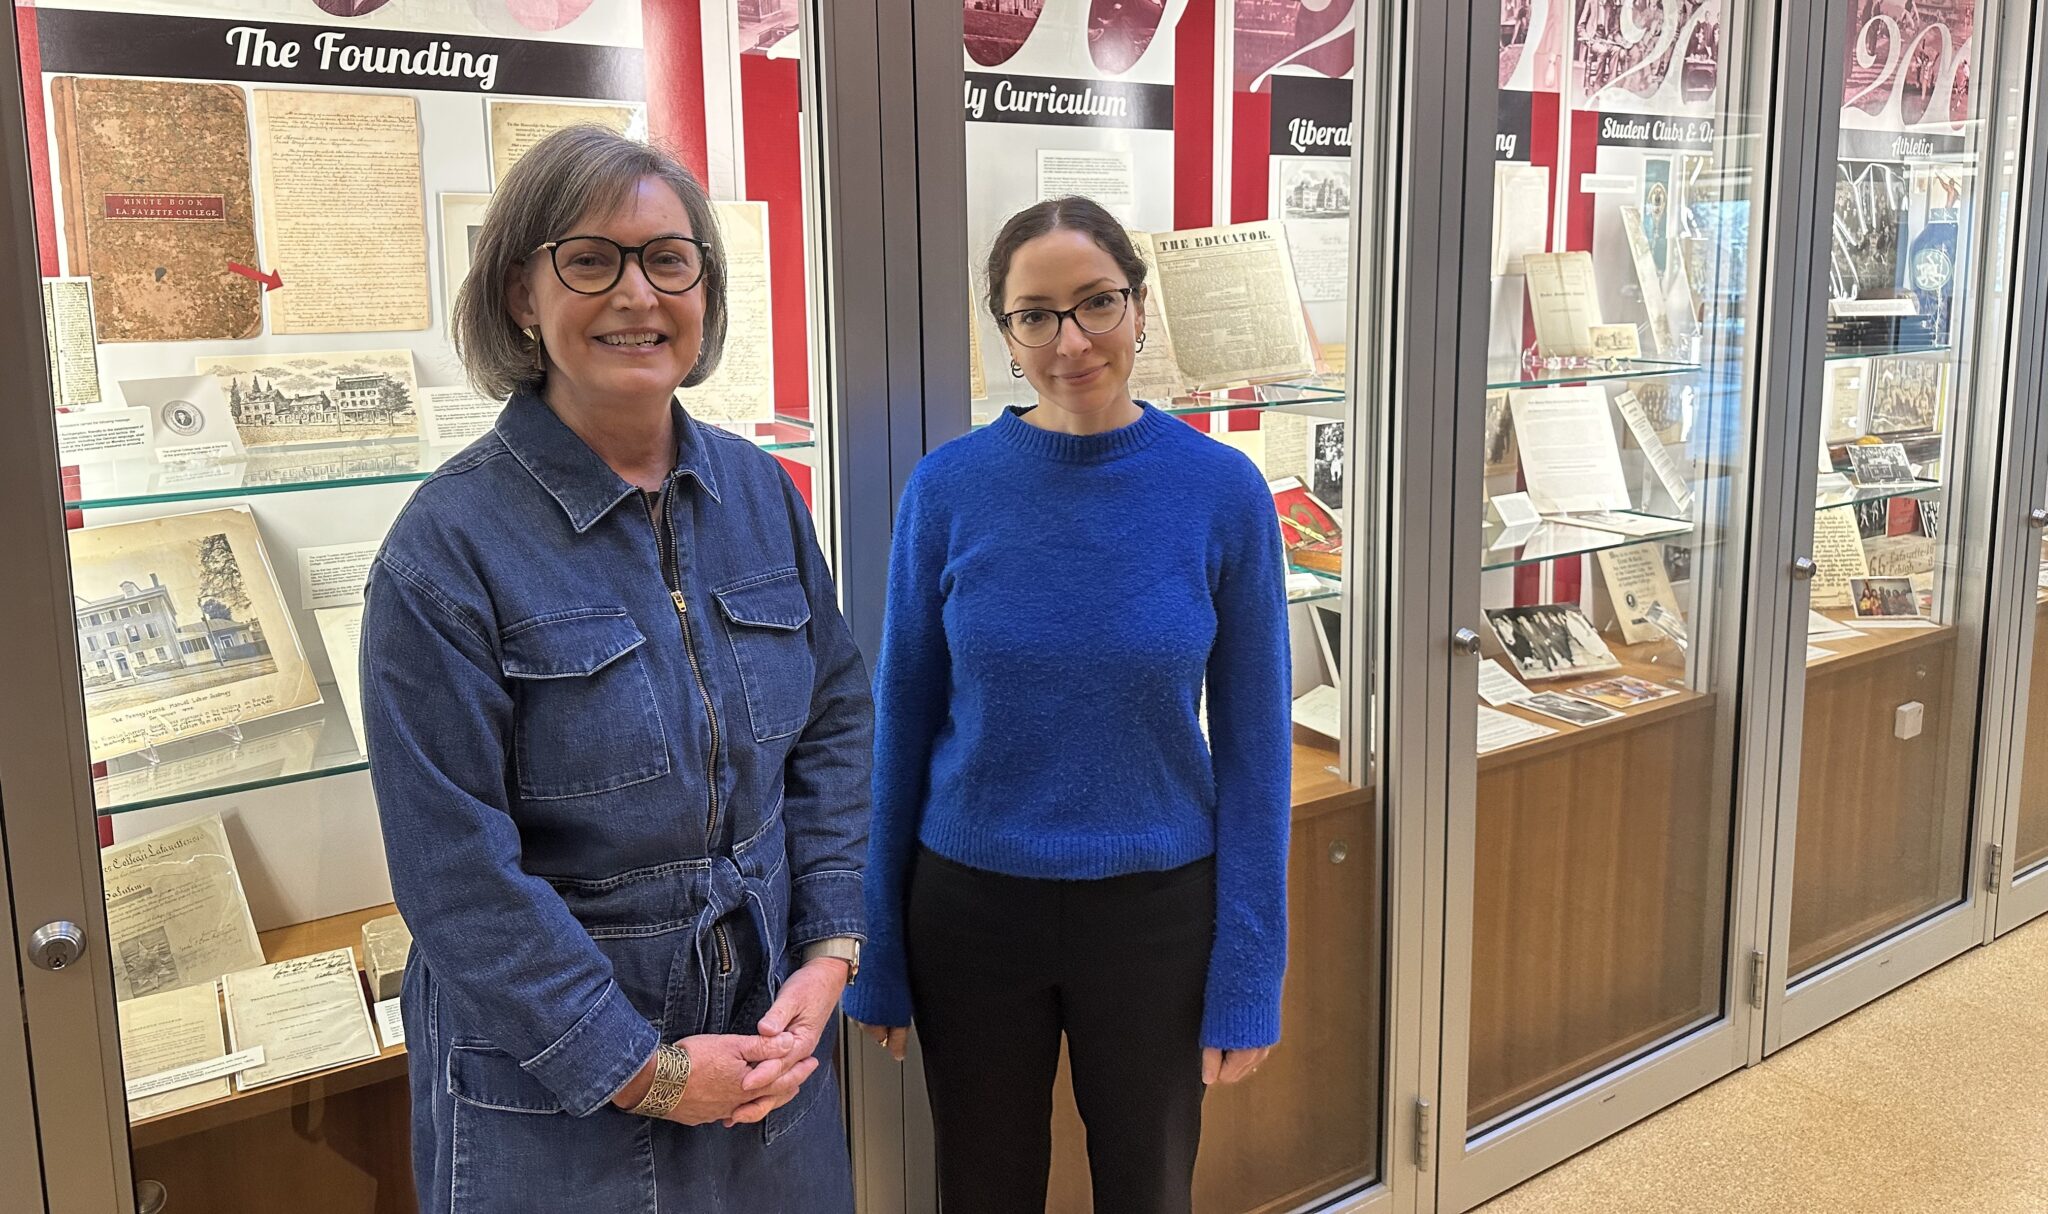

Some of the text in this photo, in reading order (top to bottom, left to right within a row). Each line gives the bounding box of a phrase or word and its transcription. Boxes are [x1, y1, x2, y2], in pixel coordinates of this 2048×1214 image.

[225, 26, 499, 90] The Founding
[994, 81, 1128, 118] Curriculum
[1602, 117, 1650, 139] Student
[1653, 120, 1683, 142] Clubs
[1686, 122, 1697, 141] &
[1891, 136, 1934, 158] Athletics
[124, 198, 203, 207] MINUTE BOOK
[131, 208, 174, 216] FAYETTE
[176, 208, 219, 217] COLLEGE.
[1160, 229, 1271, 251] THE EDUCATOR.
